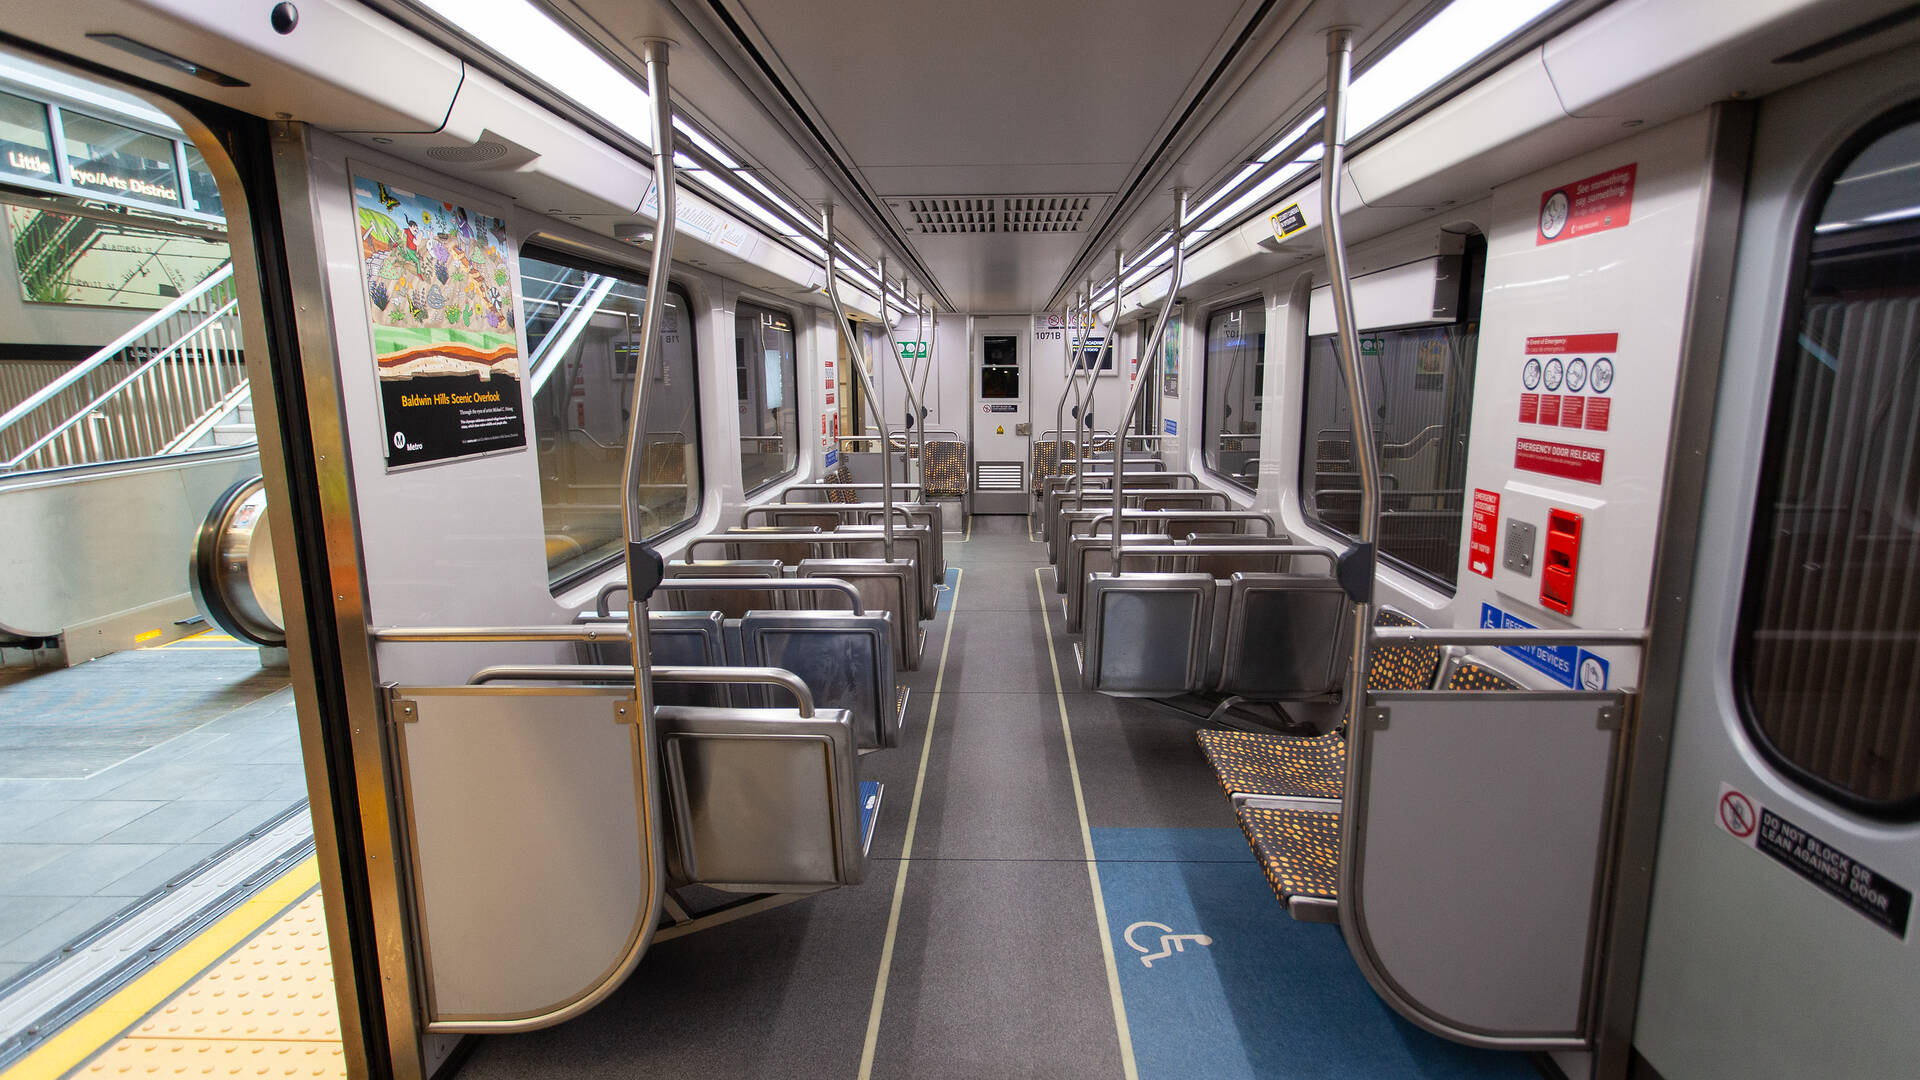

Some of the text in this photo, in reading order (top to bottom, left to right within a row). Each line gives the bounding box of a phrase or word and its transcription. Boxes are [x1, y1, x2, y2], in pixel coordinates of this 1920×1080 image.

[9, 151, 177, 200] Little kyo/Arts District
[1576, 184, 1590, 195] See
[1036, 331, 1061, 340] 1071B
[401, 390, 500, 407] Baldwin Hills Scenic Overlook
[407, 442, 423, 452] Metro
[1517, 441, 1552, 455] EMERGENCY
[1552, 446, 1569, 457] DOOR
[1570, 449, 1601, 463] RELEASE
[1475, 491, 1497, 504] EMERGENCY
[1536, 648, 1570, 673] DEVICES
[1763, 813, 1780, 830] DO
[1781, 823, 1806, 847] NOT
[1807, 838, 1849, 872] BLOCK
[1851, 864, 1872, 885] OR
[1761, 824, 1792, 853] LEAN
[1794, 845, 1848, 885] AGAINST
[1849, 878, 1888, 911] DOOR
